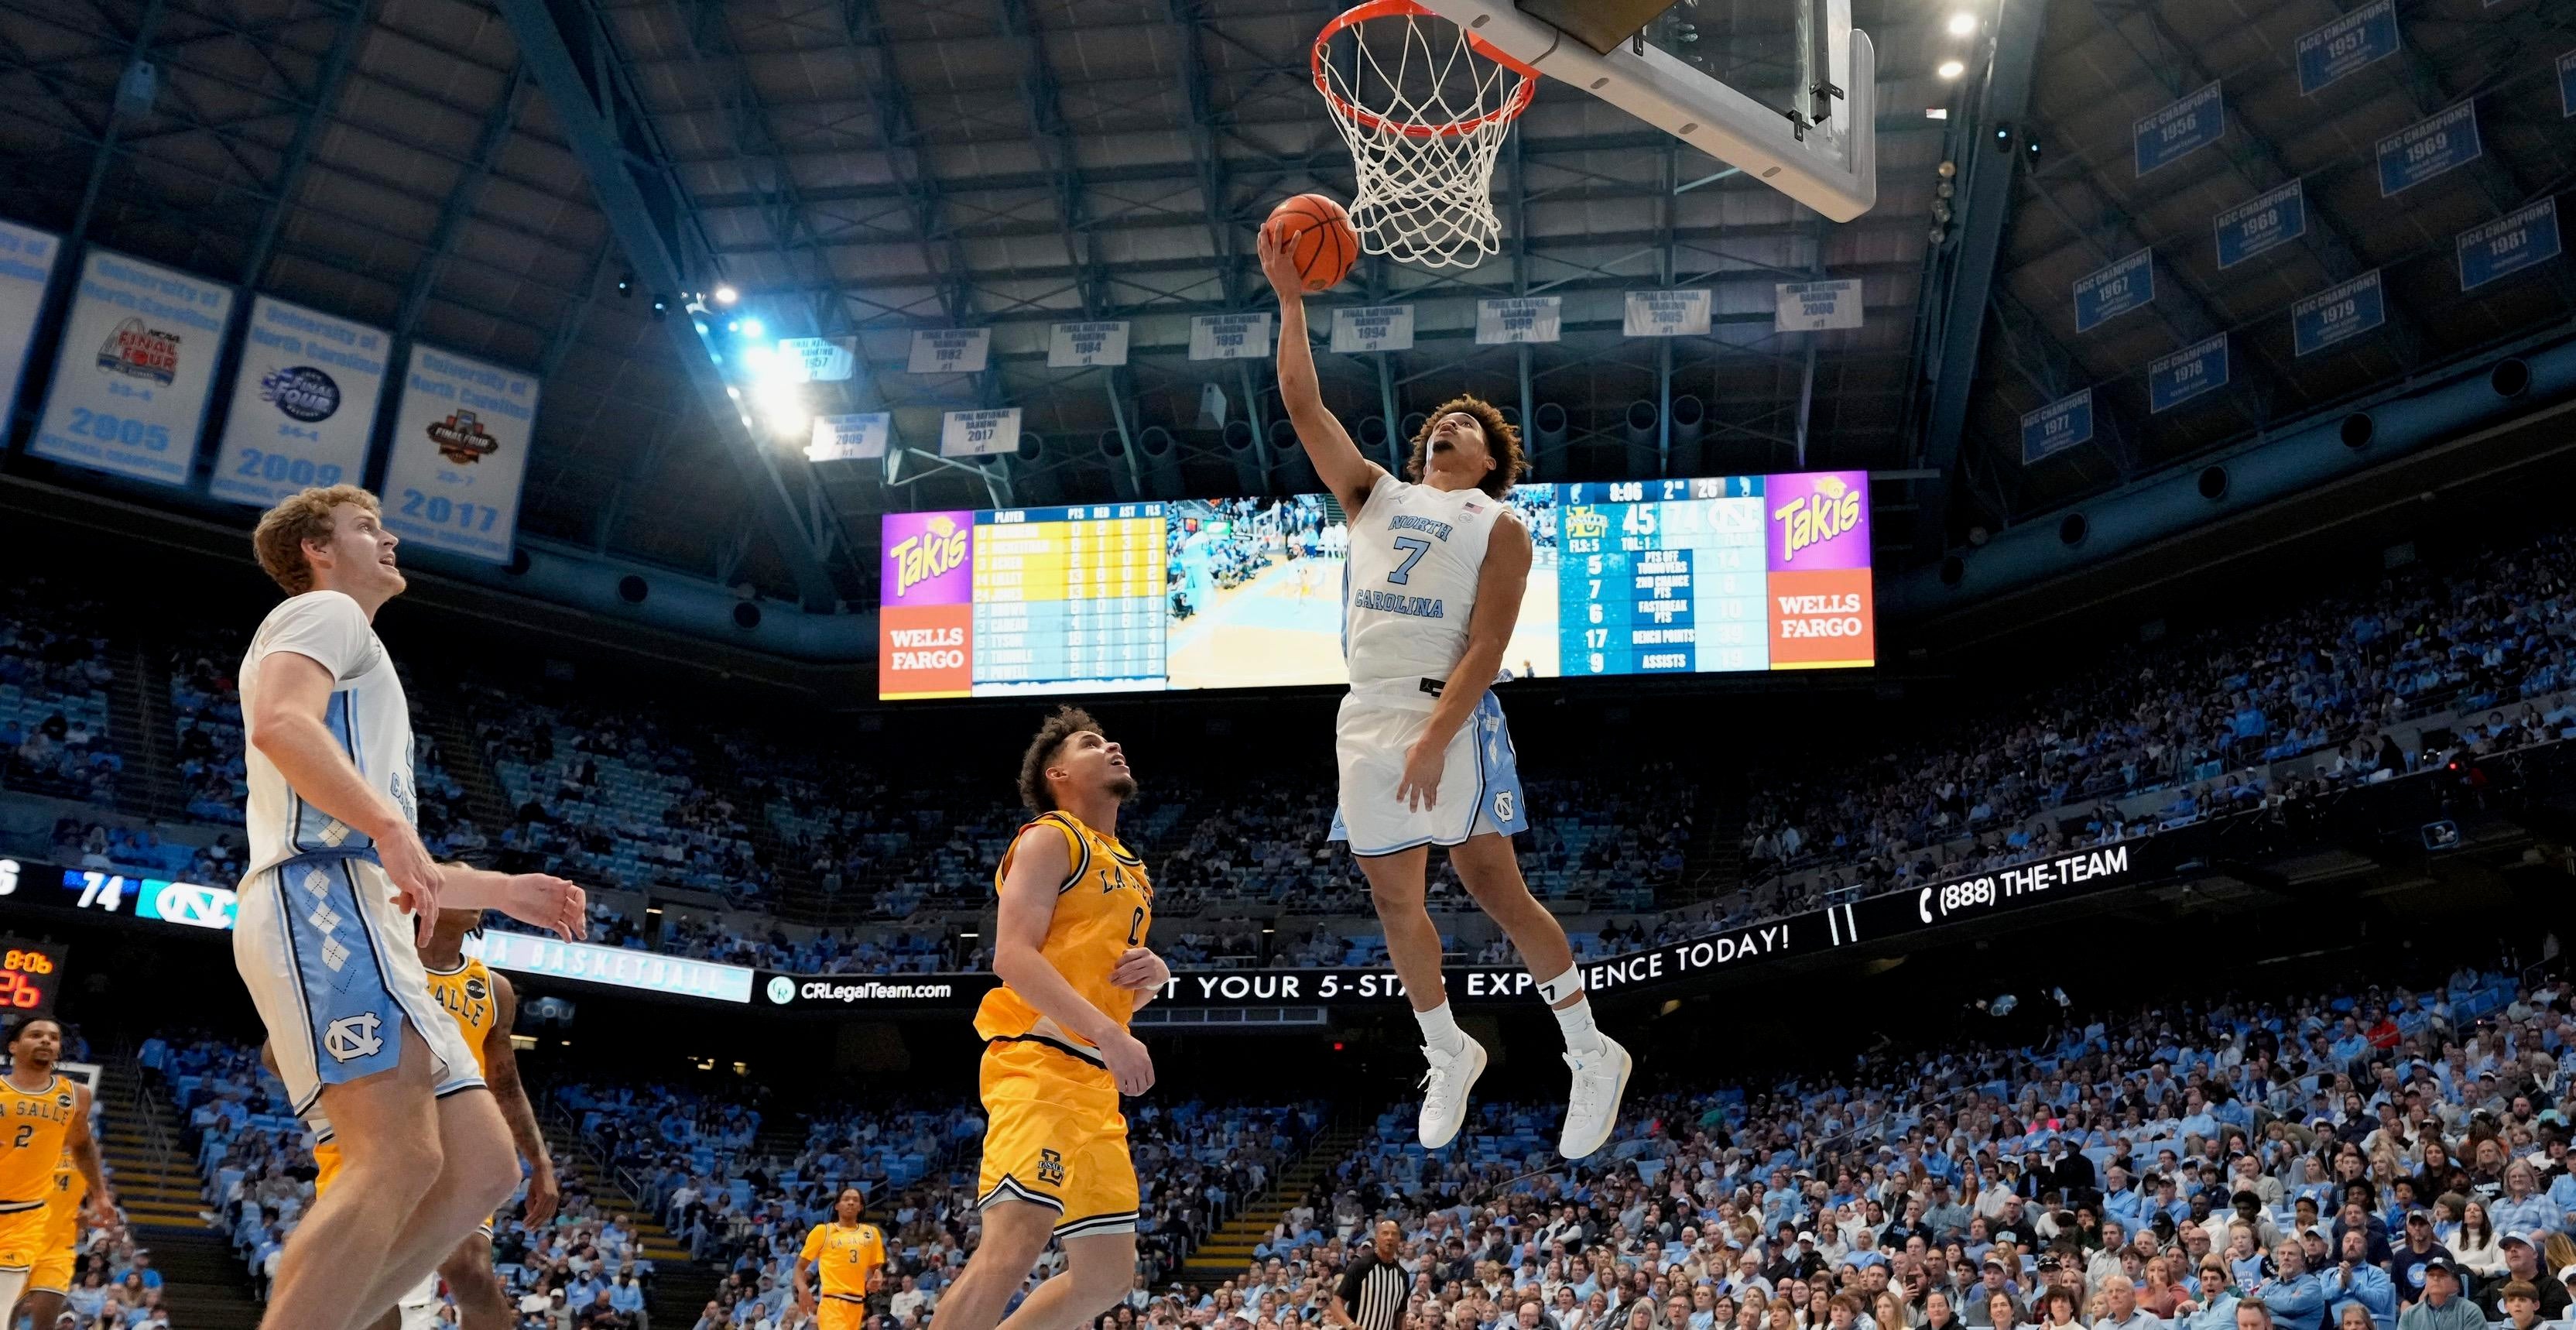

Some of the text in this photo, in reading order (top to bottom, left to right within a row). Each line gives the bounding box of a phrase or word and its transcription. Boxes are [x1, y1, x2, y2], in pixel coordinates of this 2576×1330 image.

[2300, 2, 2390, 53] ACC CHAMPIONS
[2328, 28, 2365, 59] 1957
[2138, 86, 2218, 135] ACC CHAMPIONS
[2161, 114, 2197, 142] 1956
[2379, 105, 2470, 156] ACC CHAMPIONS
[2407, 132, 2447, 163] 1969
[2218, 186, 2298, 228] ACC CHAMPIONS
[2461, 201, 2551, 249] ACC CHAMPIONS
[2490, 228, 2527, 255] 1981
[2297, 274, 2377, 316] ACC CHAMPIONS
[1813, 319, 1825, 328] #1
[2322, 300, 2356, 324] 1979
[1358, 327, 1386, 338] 1994
[1512, 332, 1523, 341] #1
[1662, 325, 1673, 334] #1
[118, 330, 176, 356] FINAL
[120, 346, 177, 372] FOUR
[272, 381, 331, 412] FOUR
[2023, 392, 2089, 427] ACC CHAMPIONS
[68, 406, 170, 452] 2005
[435, 427, 490, 448] FINAL FOUR
[968, 430, 993, 442] 2017
[2043, 414, 2070, 436] 1977
[236, 447, 343, 488] 2009
[1609, 480, 1717, 502] 8:06 26
[400, 488, 498, 533] 2017
[995, 511, 1025, 523] PLAYER
[1068, 508, 1084, 520] PTS
[1119, 506, 1136, 518] AST
[1146, 505, 1161, 517] FLS
[1622, 503, 1655, 535] 45
[1669, 502, 1698, 533] 74
[1388, 515, 1452, 543] NORTH
[1775, 490, 1860, 561] Takis
[1570, 539, 1590, 553] FLS:
[1591, 538, 1599, 552] 5
[1644, 536, 1650, 550] 1
[1645, 550, 1679, 562] PTS OFF
[890, 530, 967, 598] Takis
[1387, 536, 1430, 585] 7
[1588, 555, 1602, 574] 5
[1637, 561, 1687, 574] TURNOVERS
[1588, 579, 1601, 599] 7
[1636, 575, 1690, 589] 2ND CHANCE
[1654, 588, 1672, 599] PTS
[1355, 588, 1444, 619] CAROLINA
[1588, 604, 1603, 624] 6
[1639, 600, 1687, 613] FASTBREAK
[1779, 594, 1861, 614] WELLS
[1654, 612, 1672, 624] PTS
[1781, 618, 1862, 638] FARGO
[891, 628, 964, 647] WELLS
[1585, 629, 1608, 649] 17
[1662, 629, 1695, 643] POINTS
[892, 650, 964, 670] FARGO
[1590, 653, 1686, 673] 9 ASSISTS
[77, 872, 124, 912] 74
[1101, 865, 1128, 894] LA
[1940, 846, 2127, 917] (888) THE-TEAM
[1127, 905, 1144, 946] 0
[5, 949, 53, 974] 8:06
[530, 947, 718, 997] BASKETBALL
[1197, 924, 1790, 999] YOUR EXPIENCE TODAY!
[801, 981, 952, 1000] CRLegalTeam.com
[1541, 984, 1555, 1001] 7
[425, 985, 485, 1028] ALLE
[16, 1101, 69, 1127] SALLE
[13, 1124, 33, 1149] 2
[849, 1249, 858, 1264] 3
